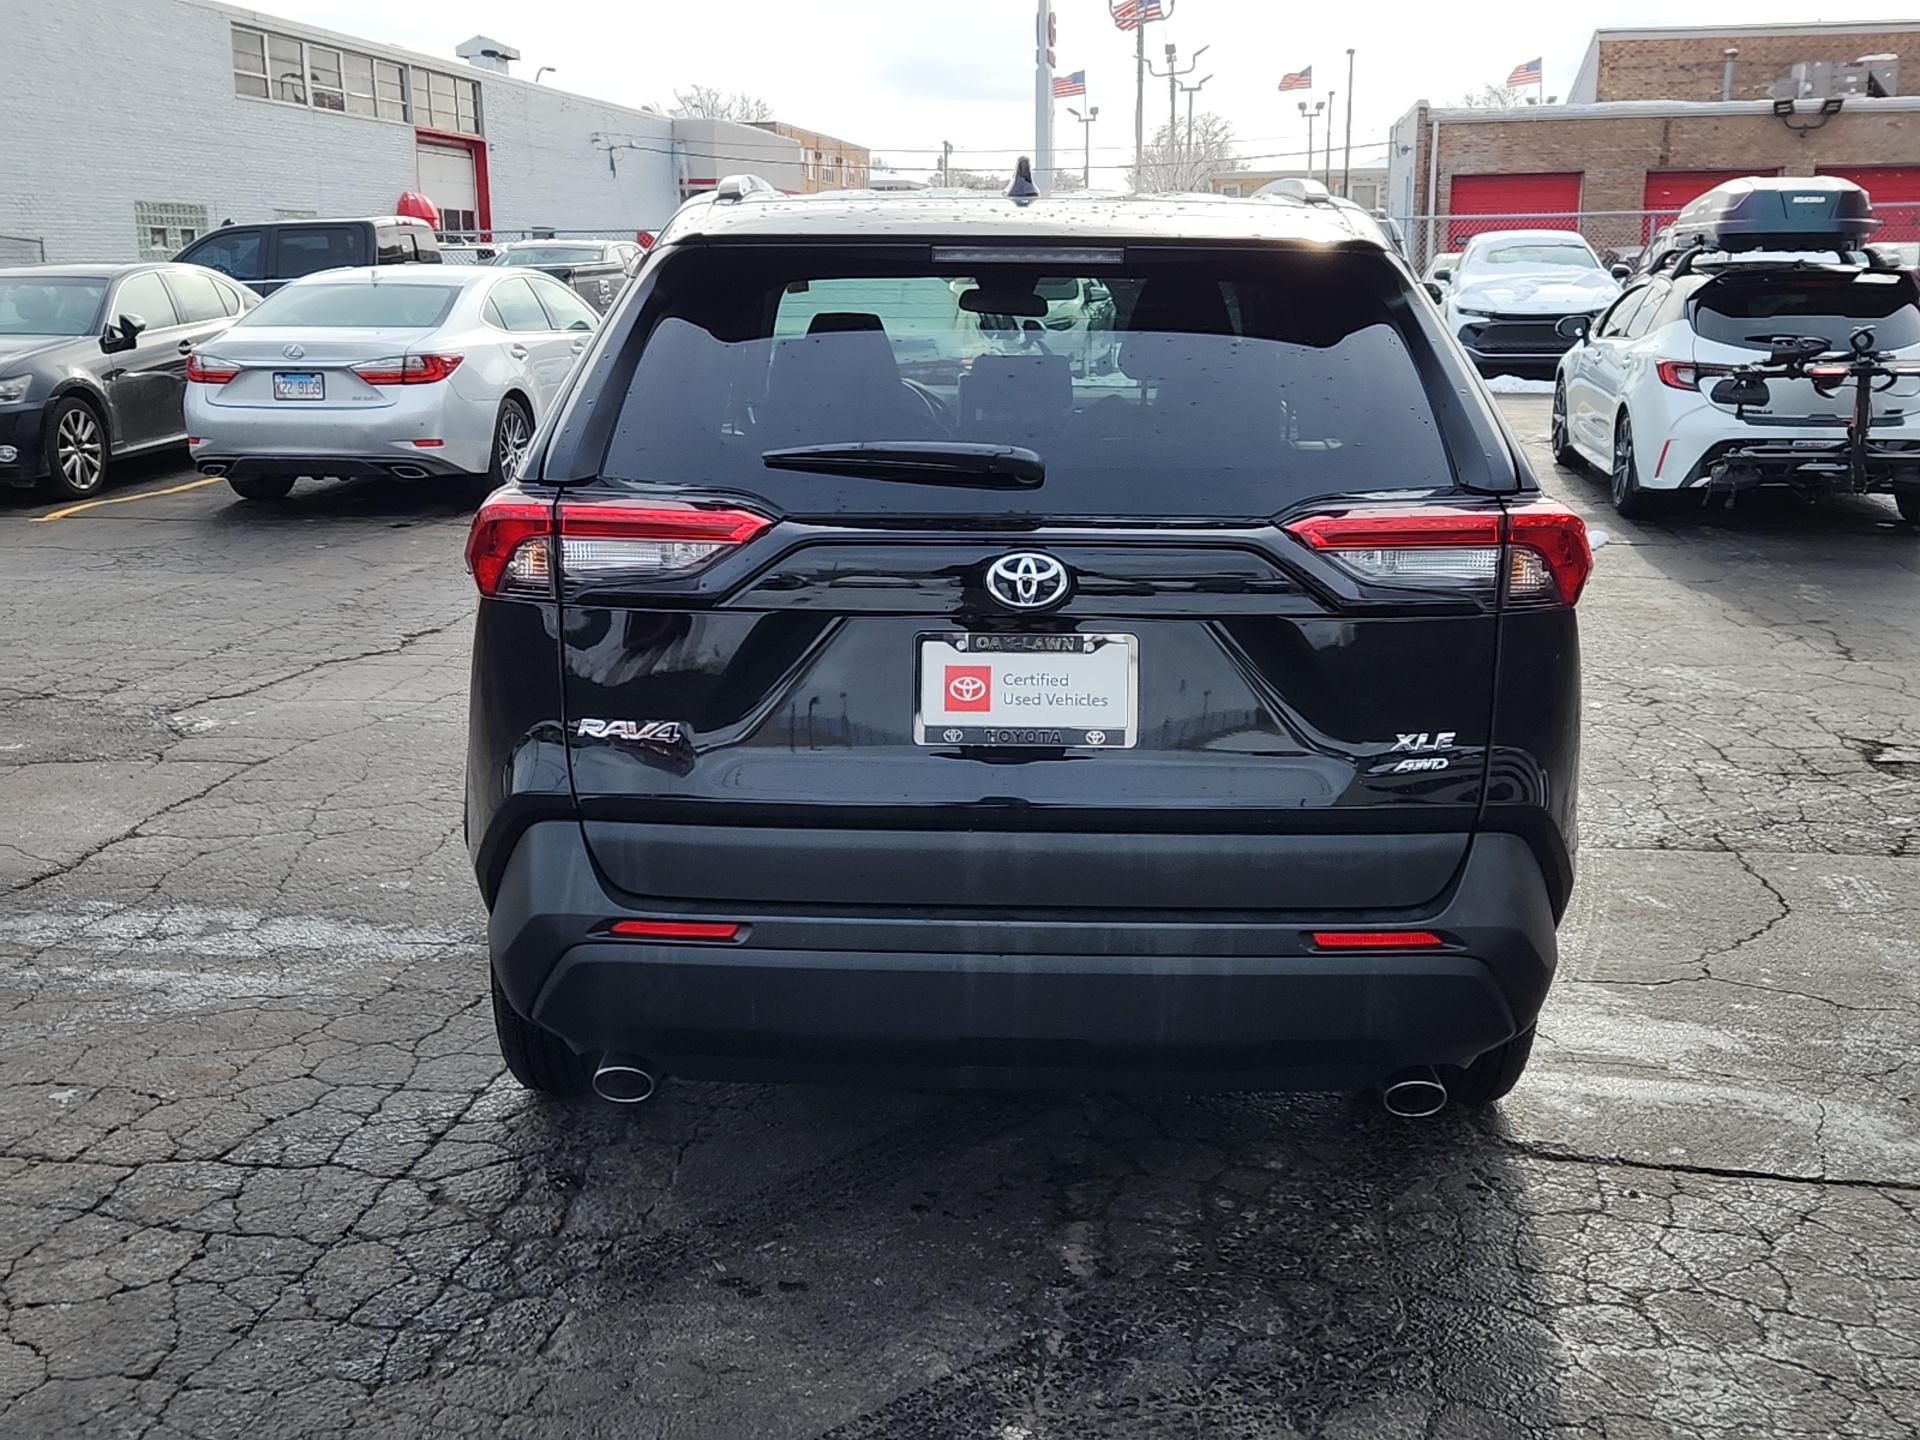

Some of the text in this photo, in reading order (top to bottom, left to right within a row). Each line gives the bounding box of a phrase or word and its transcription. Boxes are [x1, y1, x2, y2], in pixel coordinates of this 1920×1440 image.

[298, 381, 321, 395] 9139
[1002, 672, 1069, 687] Certified
[1003, 692, 1109, 707] Used Vehicles
[577, 718, 681, 743] RAV4
[984, 728, 1063, 744] TOYOTA
[1389, 731, 1456, 751] XLE
[1393, 757, 1449, 772] AWD
